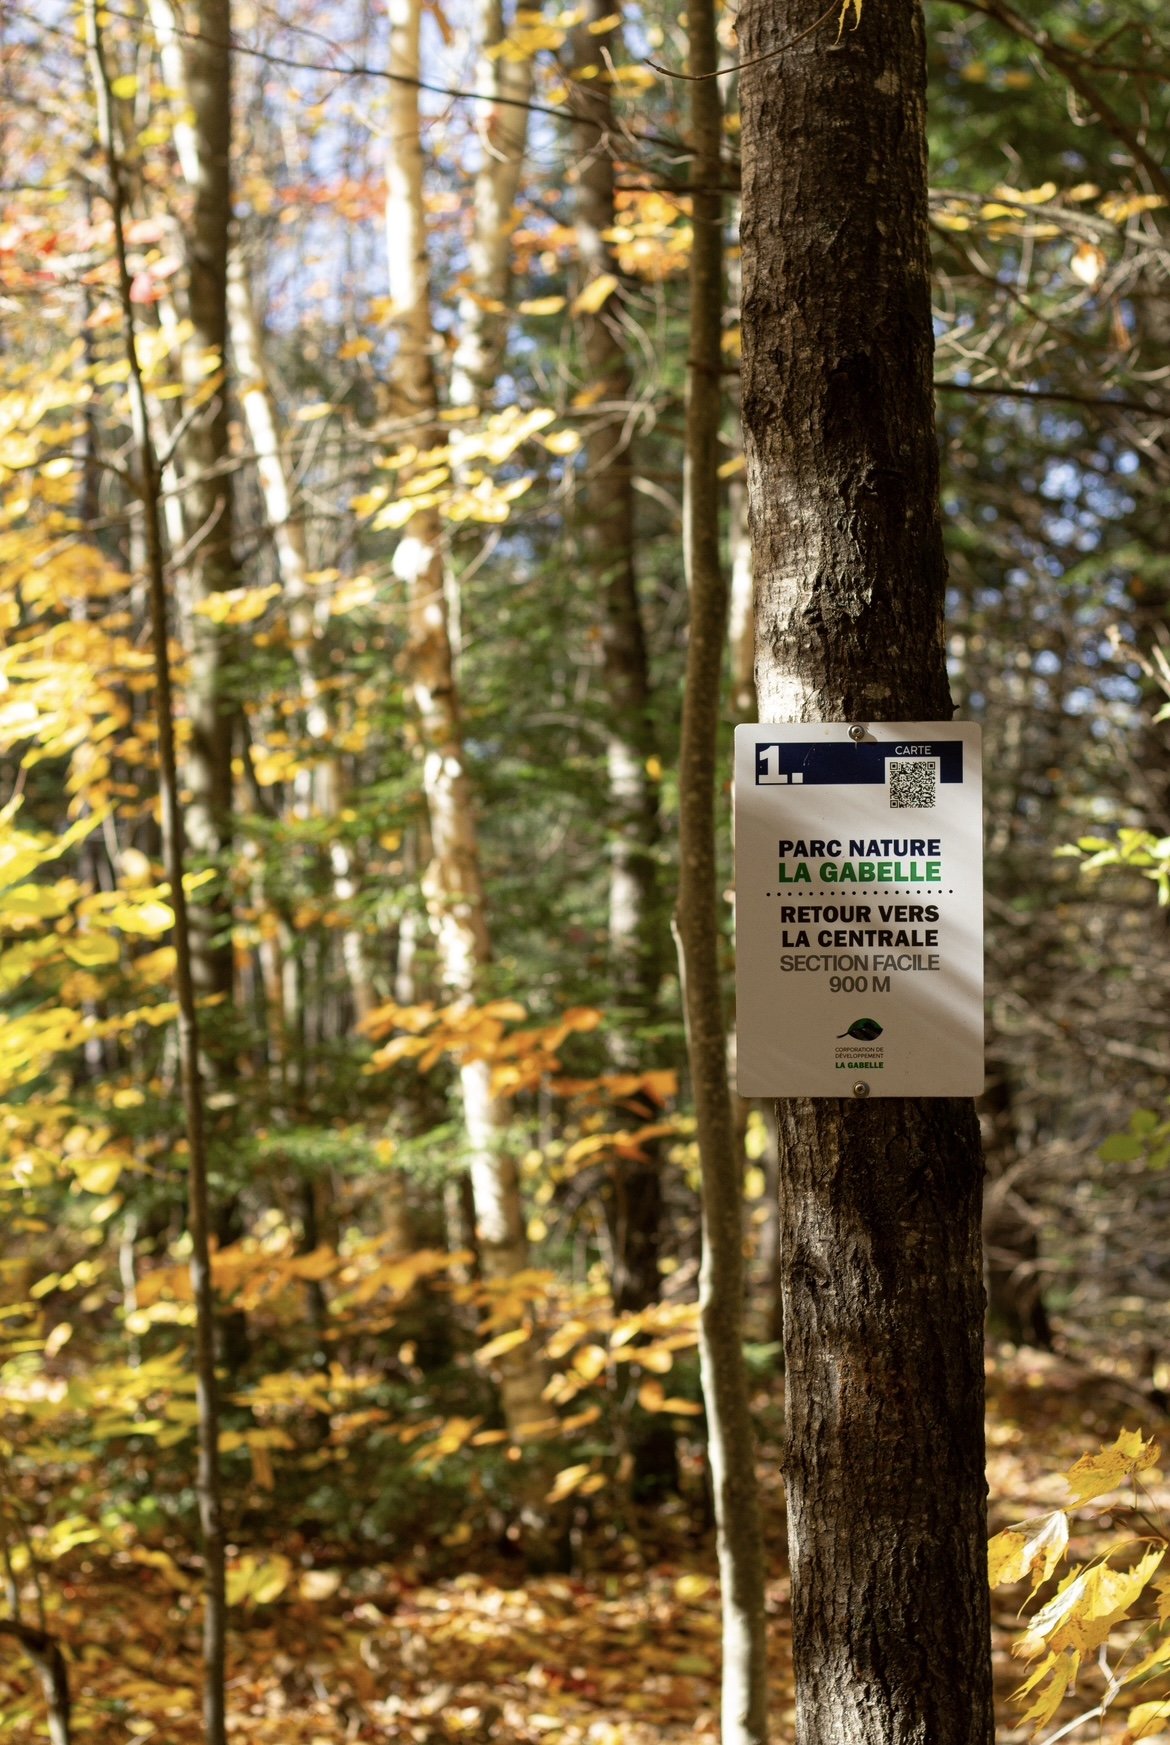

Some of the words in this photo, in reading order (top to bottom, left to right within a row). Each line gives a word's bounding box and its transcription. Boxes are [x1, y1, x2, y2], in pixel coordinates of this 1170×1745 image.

[894, 745, 932, 755] CARTE
[758, 745, 804, 784] 1.
[778, 839, 842, 857] PARC
[848, 838, 941, 857] NATURE
[778, 862, 812, 883] LA
[819, 861, 942, 882] GABELLE
[780, 905, 871, 923] RETOUR
[878, 905, 940, 923] VERS
[782, 930, 810, 948] LA
[817, 929, 939, 947] CENTRALE
[779, 955, 869, 972] SECTION
[873, 954, 940, 971] FACILE
[829, 976, 868, 993] 900
[872, 976, 891, 992] M
